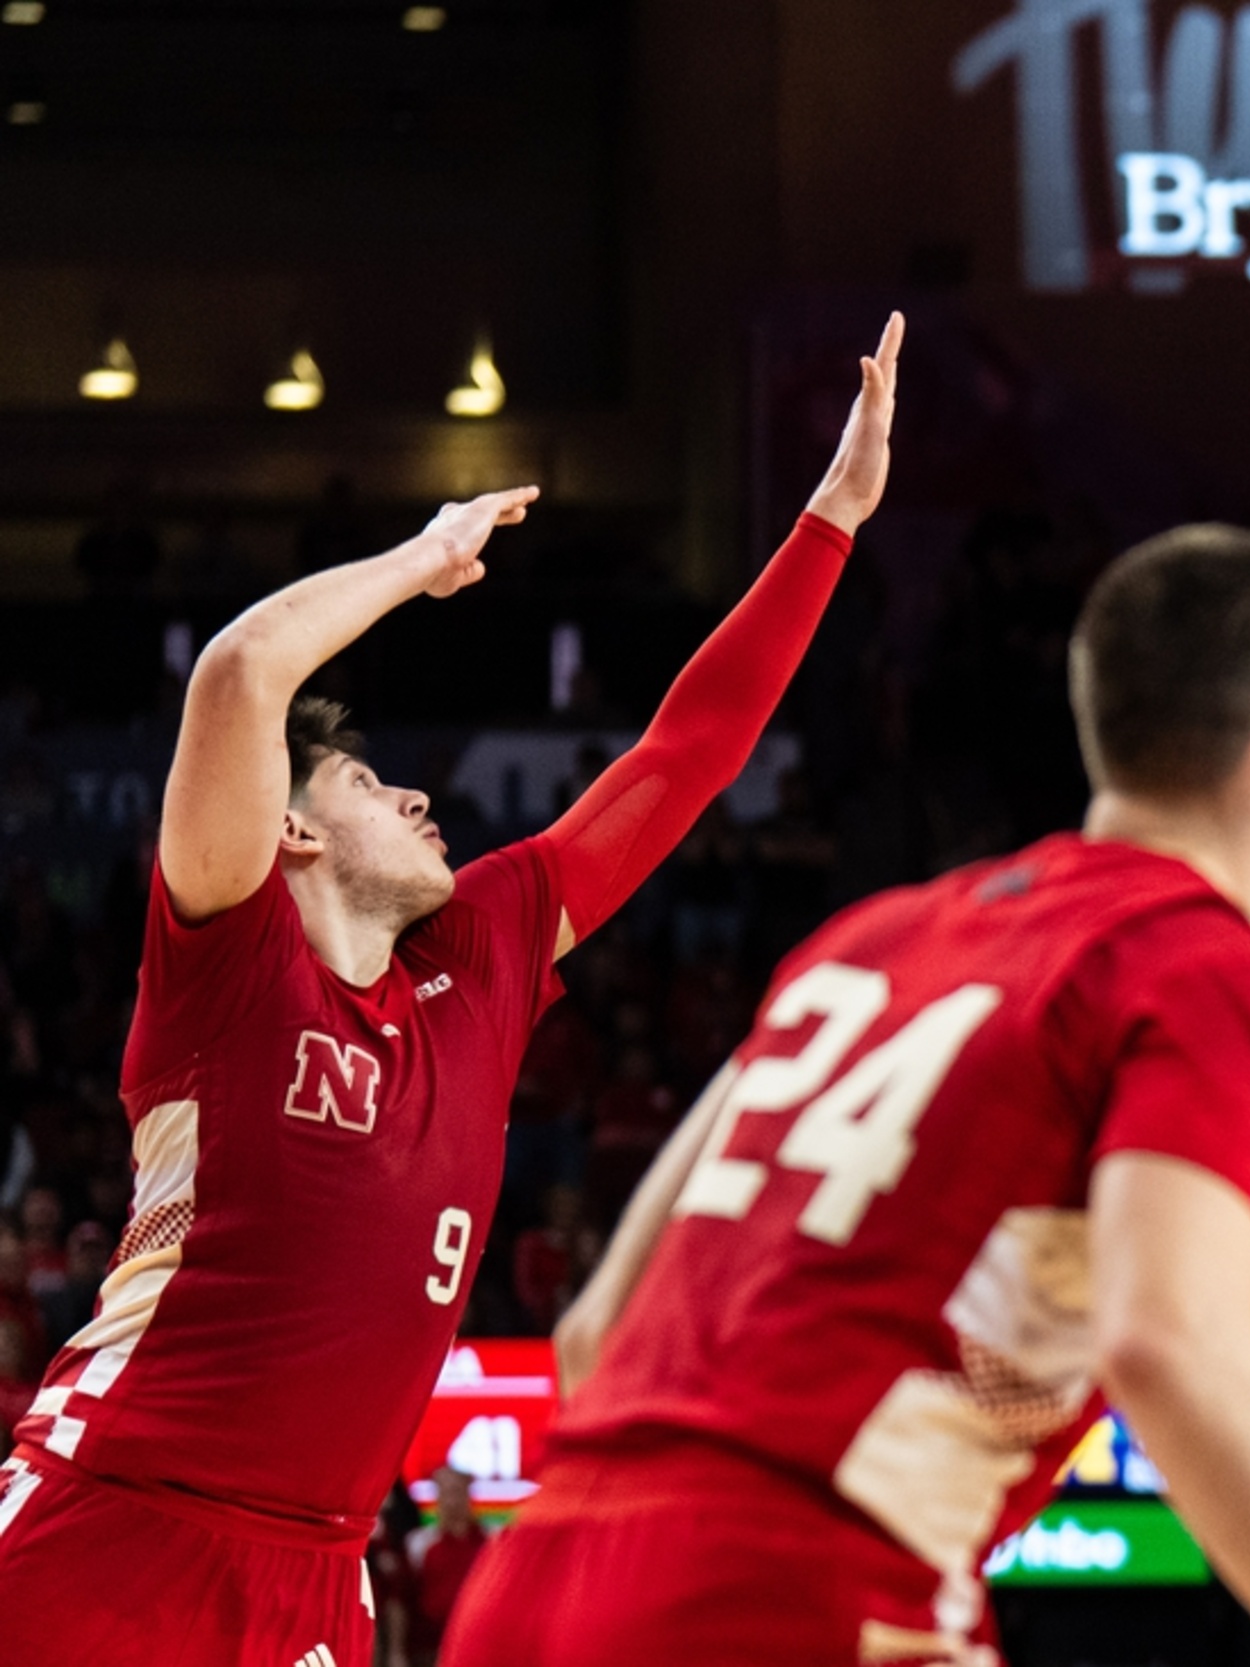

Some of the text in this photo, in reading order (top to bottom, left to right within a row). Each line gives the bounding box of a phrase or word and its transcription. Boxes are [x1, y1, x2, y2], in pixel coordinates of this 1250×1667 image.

[284, 1029, 380, 1134] N
[672, 961, 1003, 1247] 24
[425, 1206, 471, 1305] 9
[447, 1414, 521, 1480] 41
